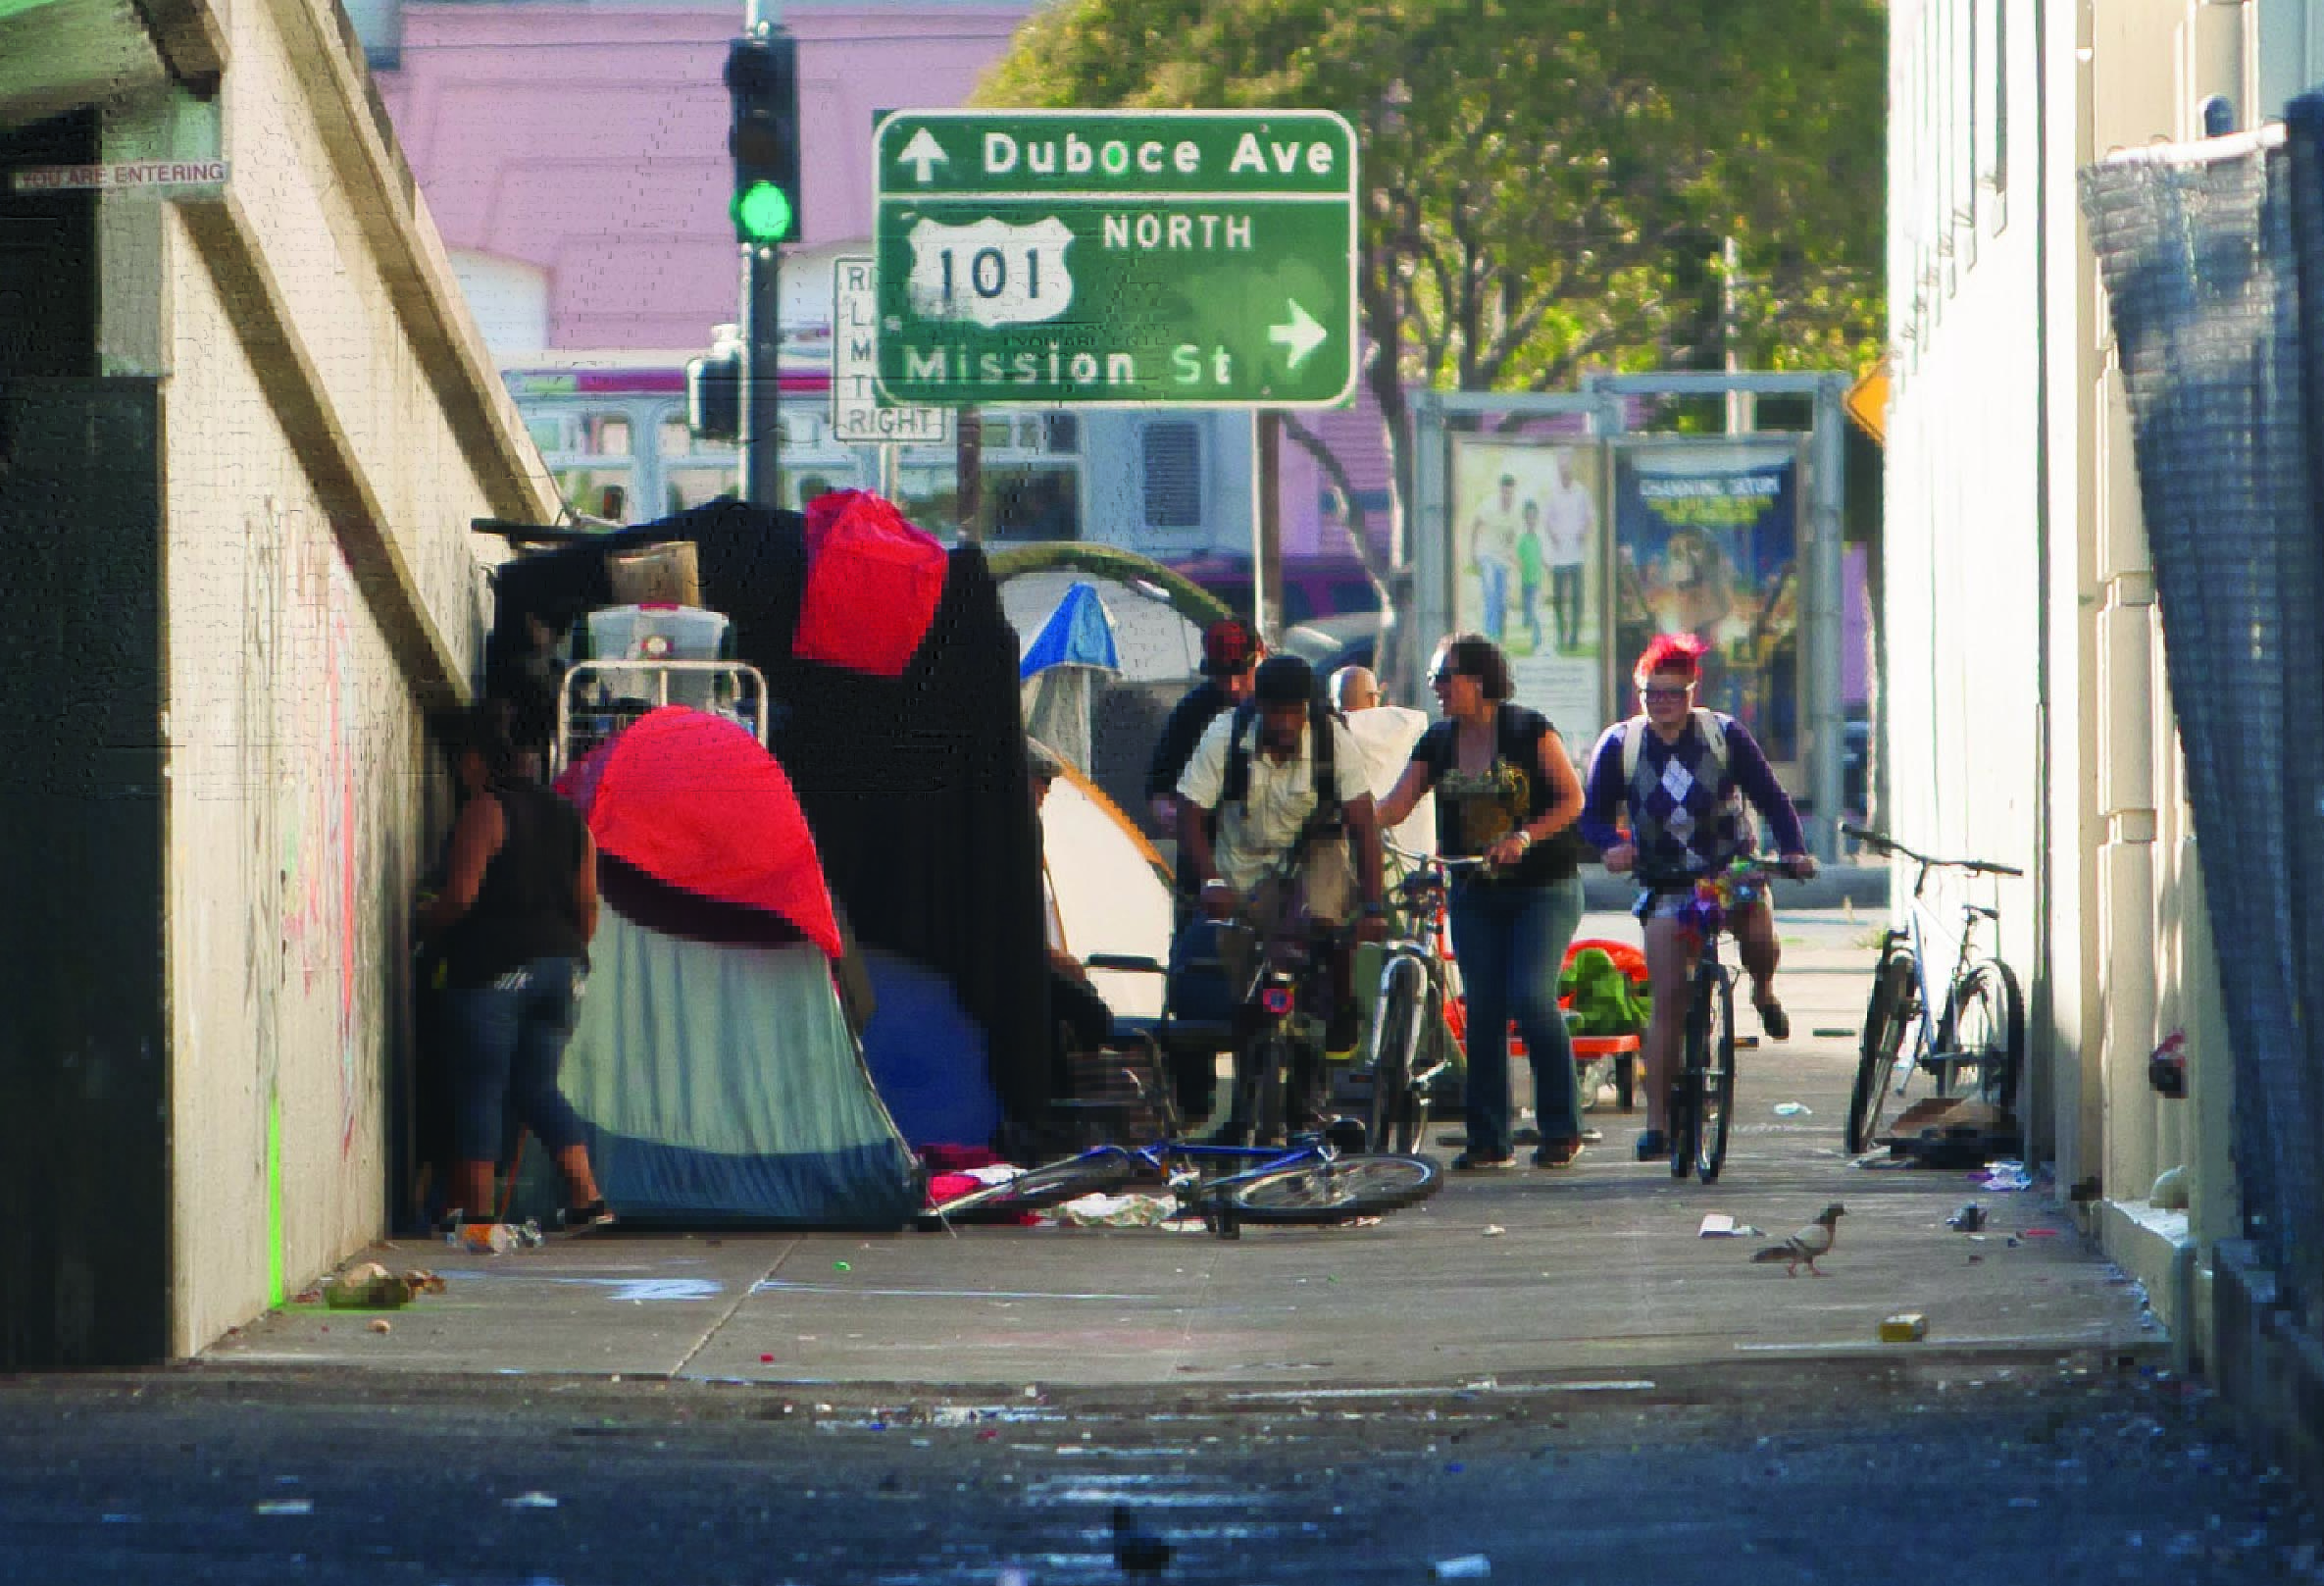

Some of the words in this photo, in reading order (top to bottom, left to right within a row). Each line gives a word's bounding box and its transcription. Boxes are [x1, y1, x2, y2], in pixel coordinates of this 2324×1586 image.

[985, 131, 1201, 176] Duboce
[1229, 132, 1334, 175] Ave
[23, 168, 62, 188] YOU
[69, 168, 106, 184] ARE
[115, 163, 225, 182] ENTERING
[1102, 216, 1253, 250] NORTH
[939, 248, 1041, 300] 101
[902, 343, 1136, 385] Mission
[1173, 343, 1233, 384] St
[848, 409, 933, 434] RIGHT
